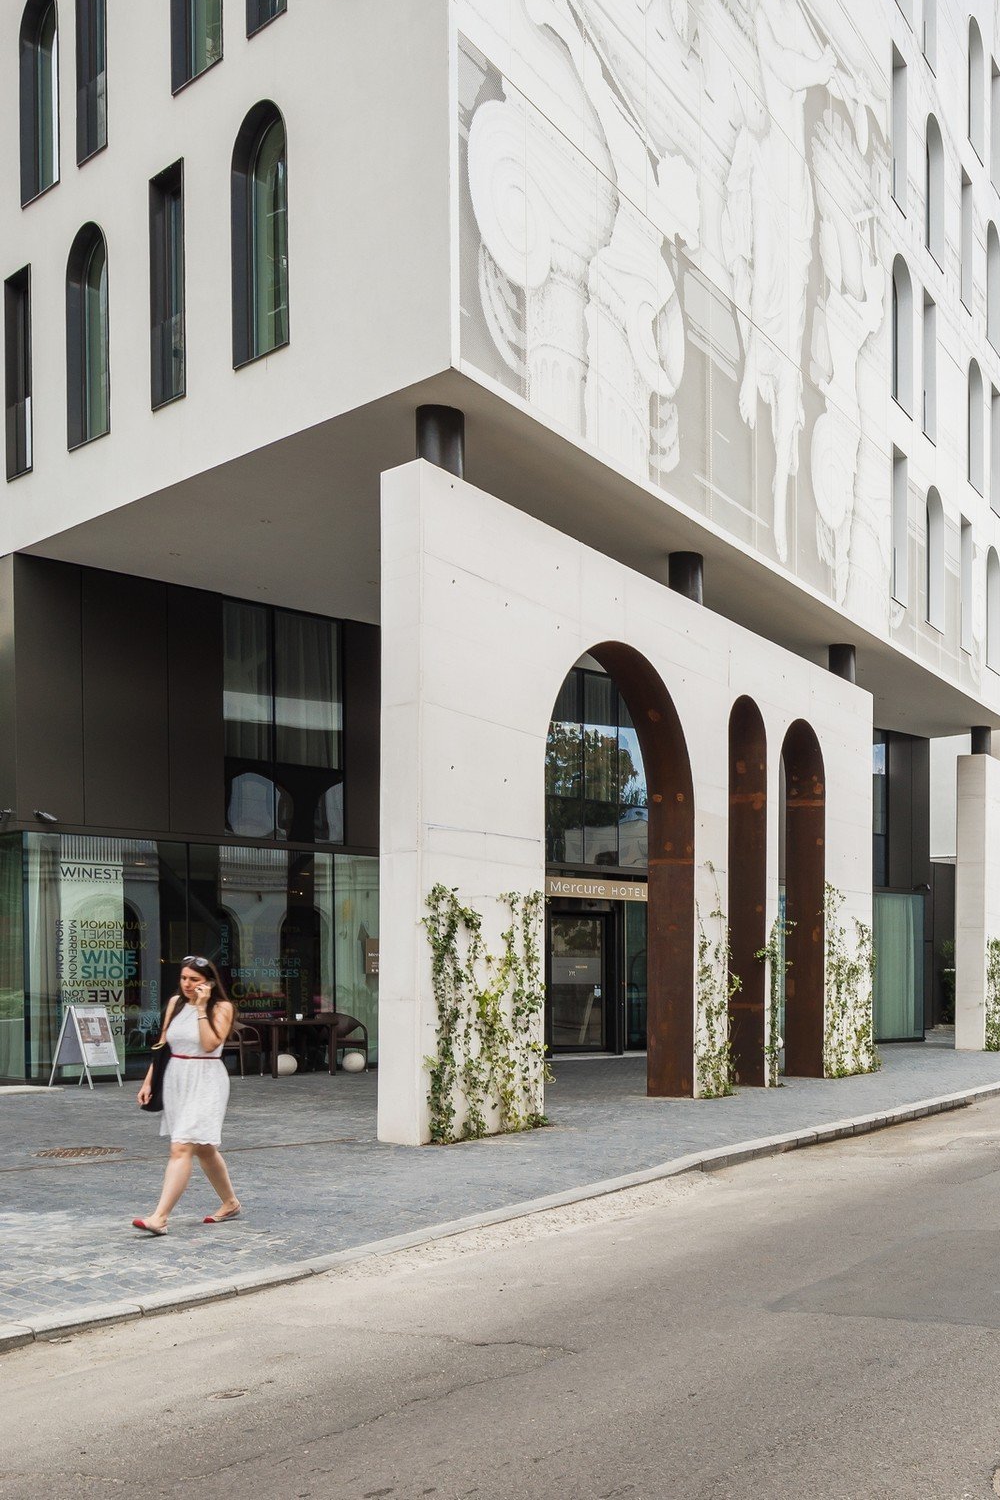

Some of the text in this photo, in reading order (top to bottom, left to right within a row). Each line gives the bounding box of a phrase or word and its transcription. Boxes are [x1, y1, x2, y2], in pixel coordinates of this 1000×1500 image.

[61, 866, 123, 880] WINEST
[550, 881, 646, 897] Mercure HOTEL
[68, 920, 78, 980] MARRENON
[81, 939, 147, 950] BORDEAUX
[83, 949, 136, 965] WINE
[81, 965, 136, 979] SHOP
[231, 969, 299, 978] BEST PRICES
[62, 980, 114, 988] AUVIGNON
[62, 989, 85, 997] INOT
